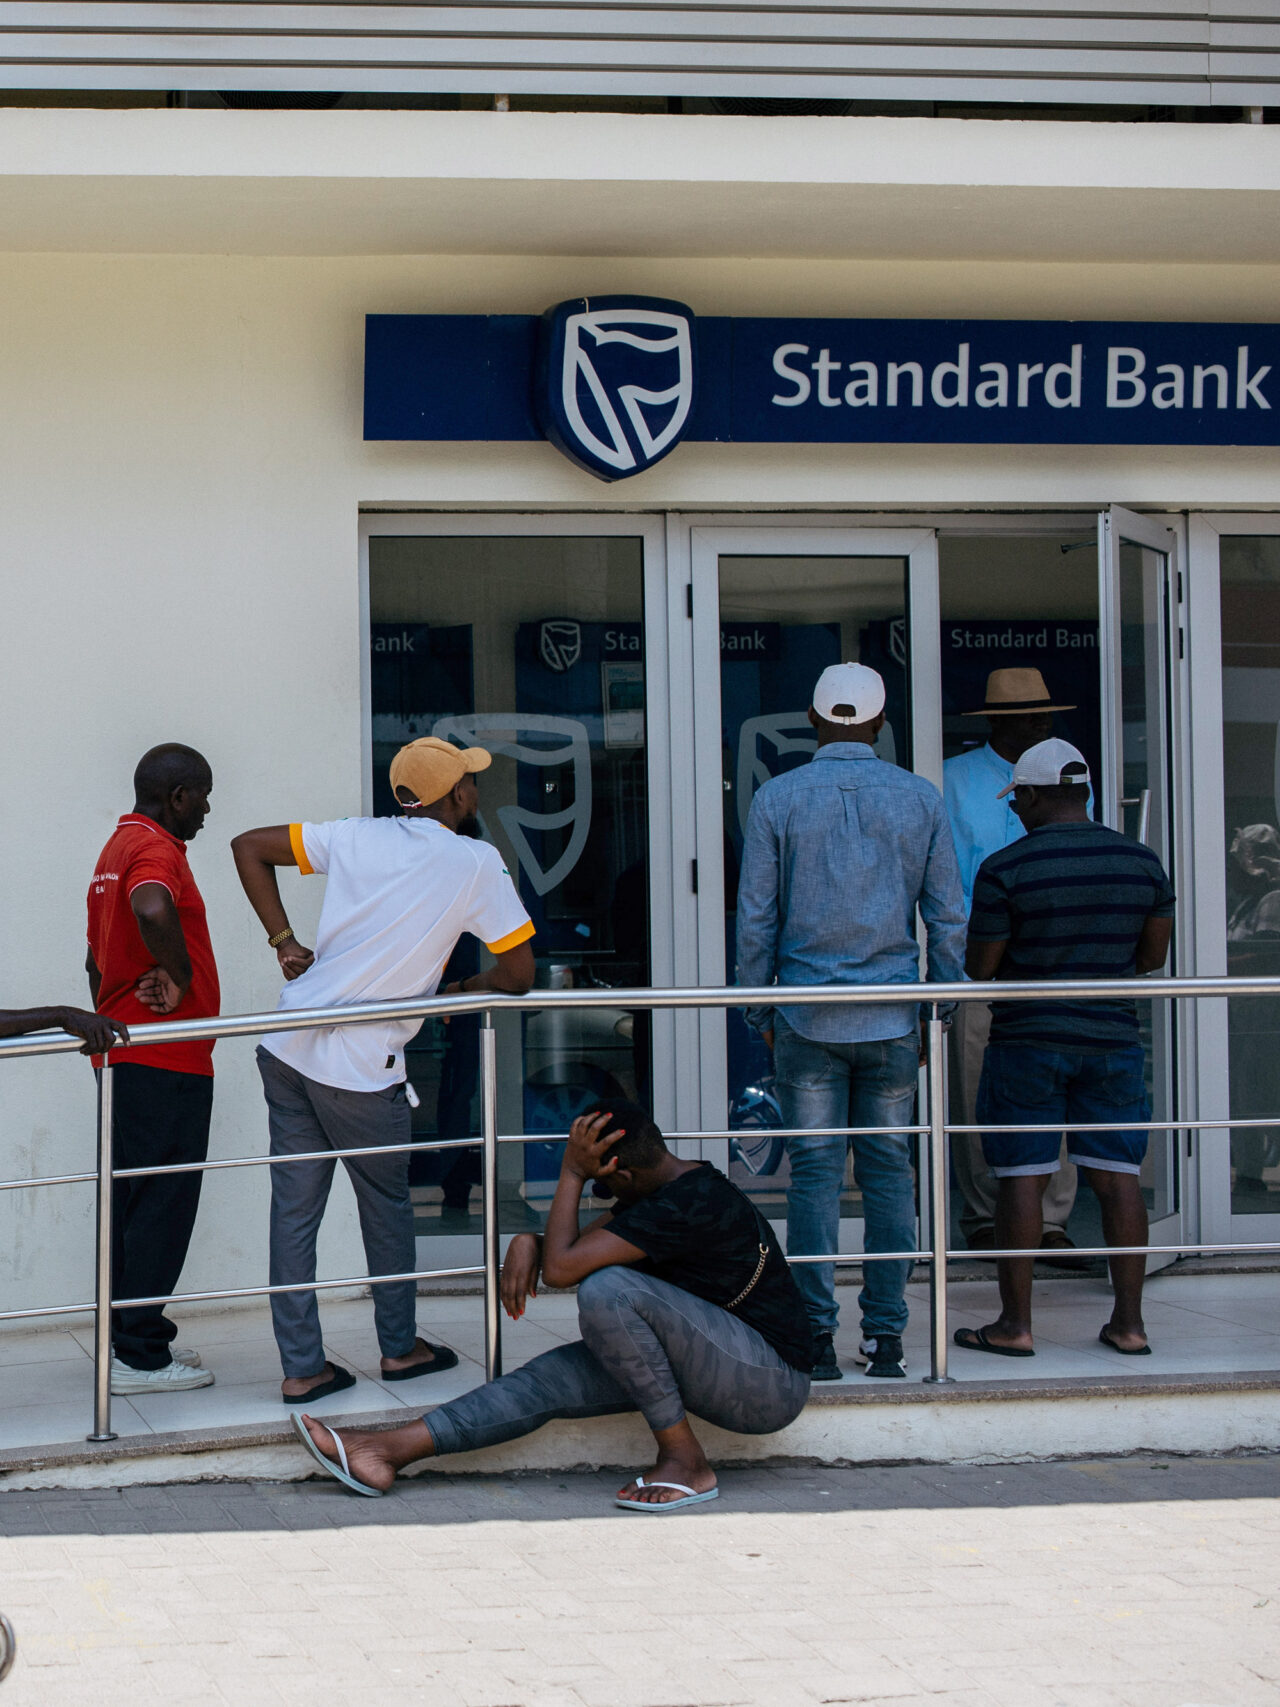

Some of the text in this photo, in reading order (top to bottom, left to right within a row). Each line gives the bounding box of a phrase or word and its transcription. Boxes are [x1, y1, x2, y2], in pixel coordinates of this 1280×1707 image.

[771, 342, 1273, 410] Standard Bank
[372, 630, 415, 652] ank
[951, 628, 1047, 648] Standard
